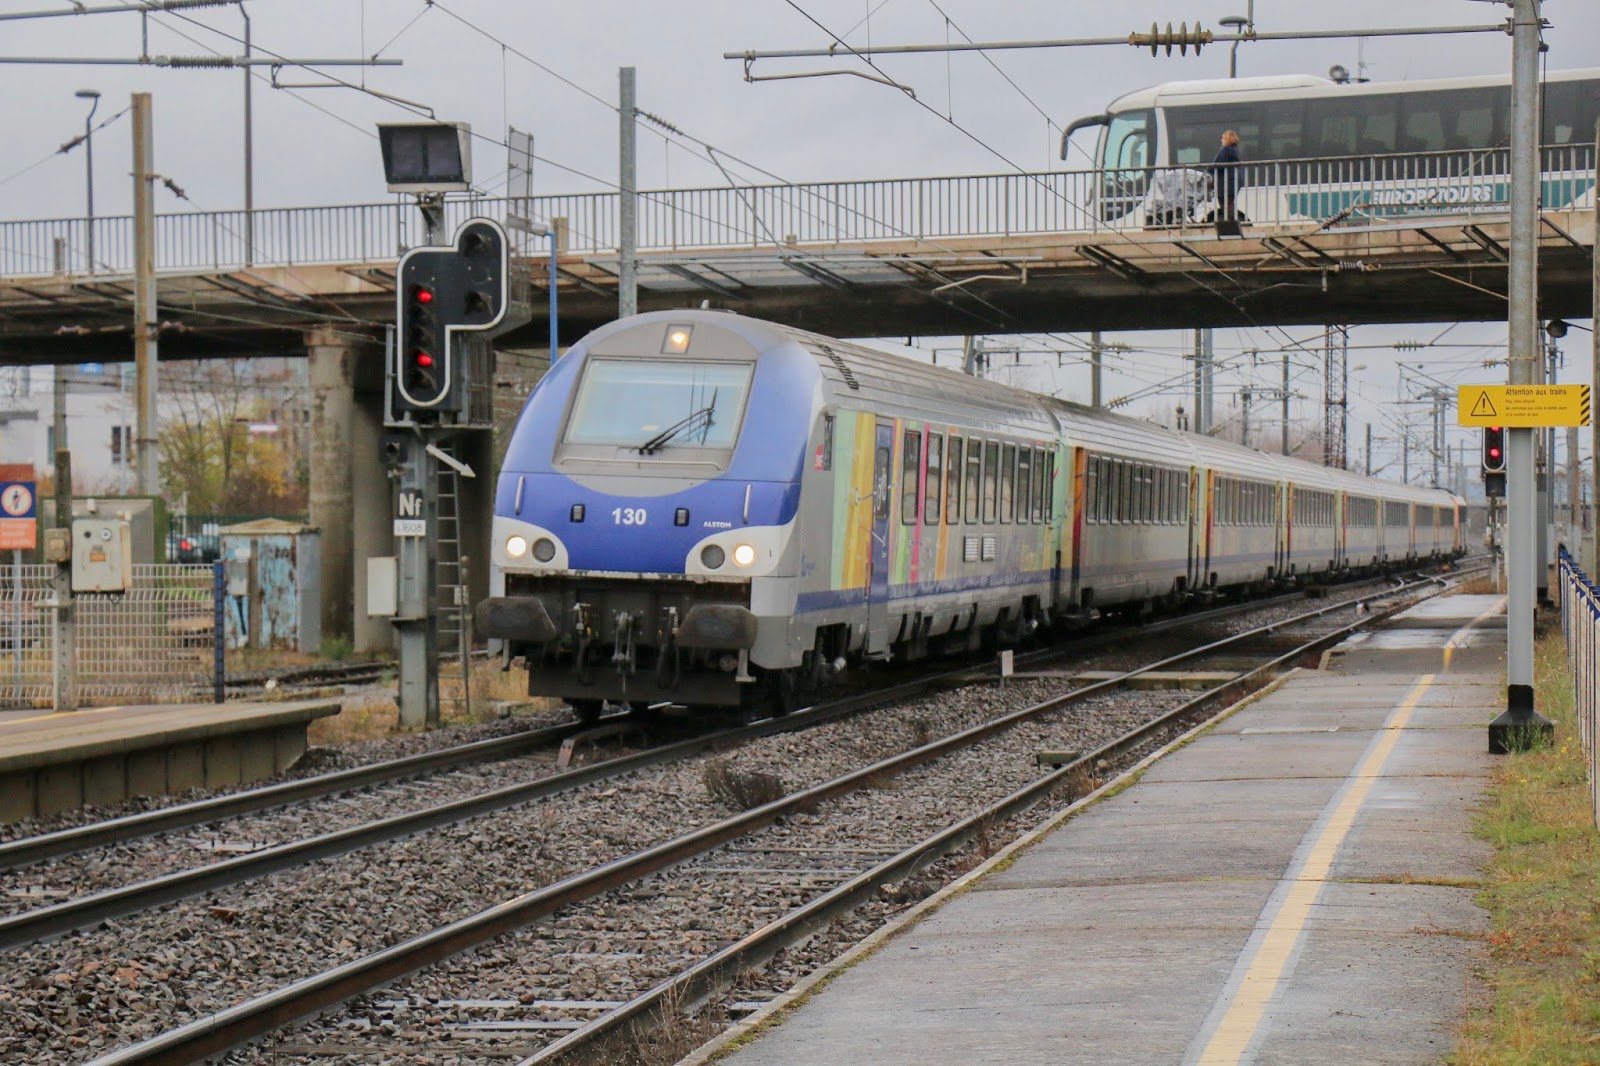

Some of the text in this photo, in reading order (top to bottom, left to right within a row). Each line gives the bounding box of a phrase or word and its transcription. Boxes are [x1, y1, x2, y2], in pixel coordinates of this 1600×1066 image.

[1505, 388, 1534, 396] Attention
[1549, 388, 1567, 396] trains
[399, 492, 422, 517] Nf
[611, 507, 647, 526] 130
[703, 521, 732, 529] ALSTOM
